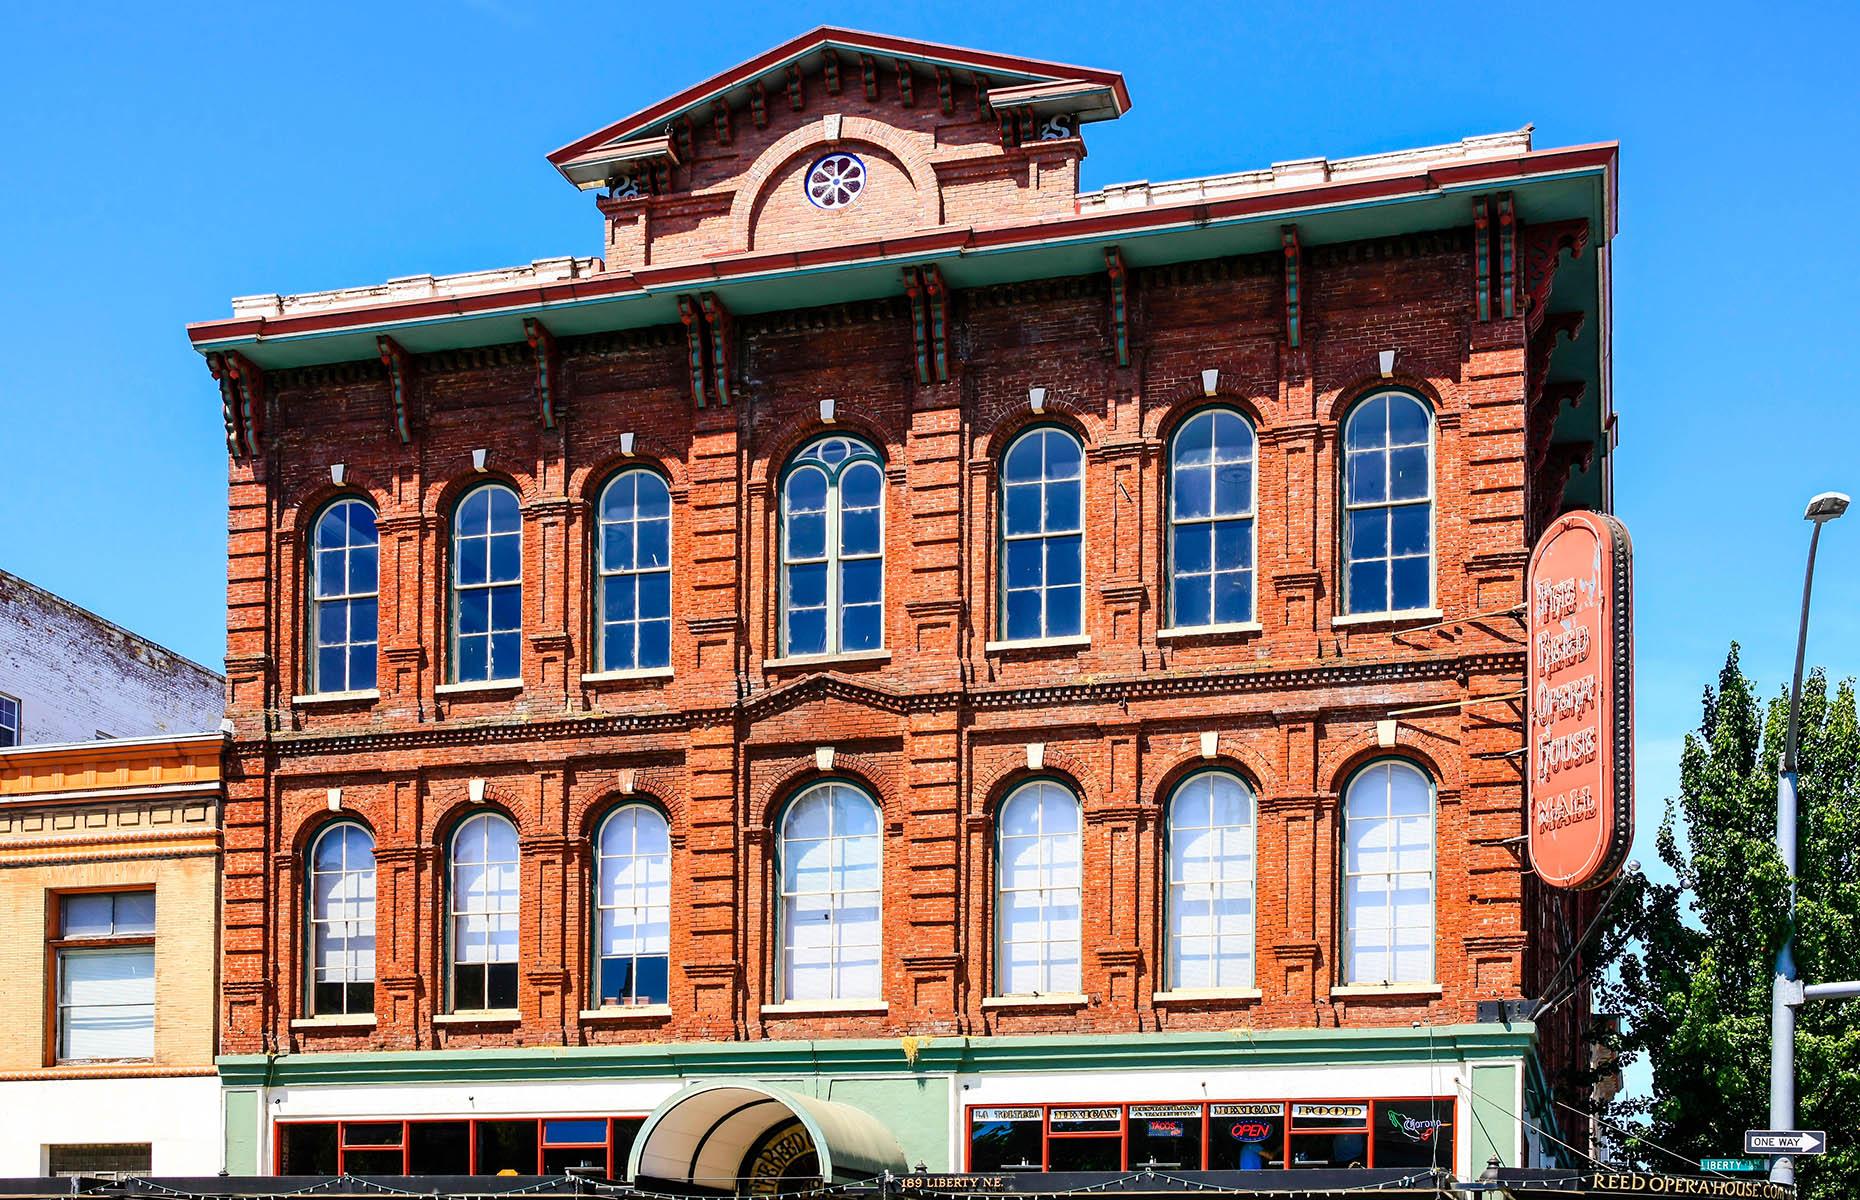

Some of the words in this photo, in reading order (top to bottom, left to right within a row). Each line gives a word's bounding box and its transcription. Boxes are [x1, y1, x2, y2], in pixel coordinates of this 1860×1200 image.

[1537, 626, 1591, 679] REED
[1537, 675, 1596, 724] OPERA
[1537, 727, 1597, 782] HOUSE
[1537, 786, 1597, 834] MALL
[975, 1110, 989, 1120] LA
[994, 1109, 1040, 1119] TOLTECA
[1054, 1109, 1118, 1119] MEXICAN
[1214, 1105, 1280, 1115] MEXICAN
[1298, 1106, 1361, 1116] FOOD
[1151, 1122, 1176, 1130] TACOS
[1231, 1123, 1270, 1137] OPEN
[1754, 1137, 1775, 1147] ONE
[1778, 1137, 1801, 1147] WAY
[1700, 1161, 1742, 1170] LIBERTY
[901, 1178, 923, 1188] 189
[927, 1178, 979, 1188] LIBERTY
